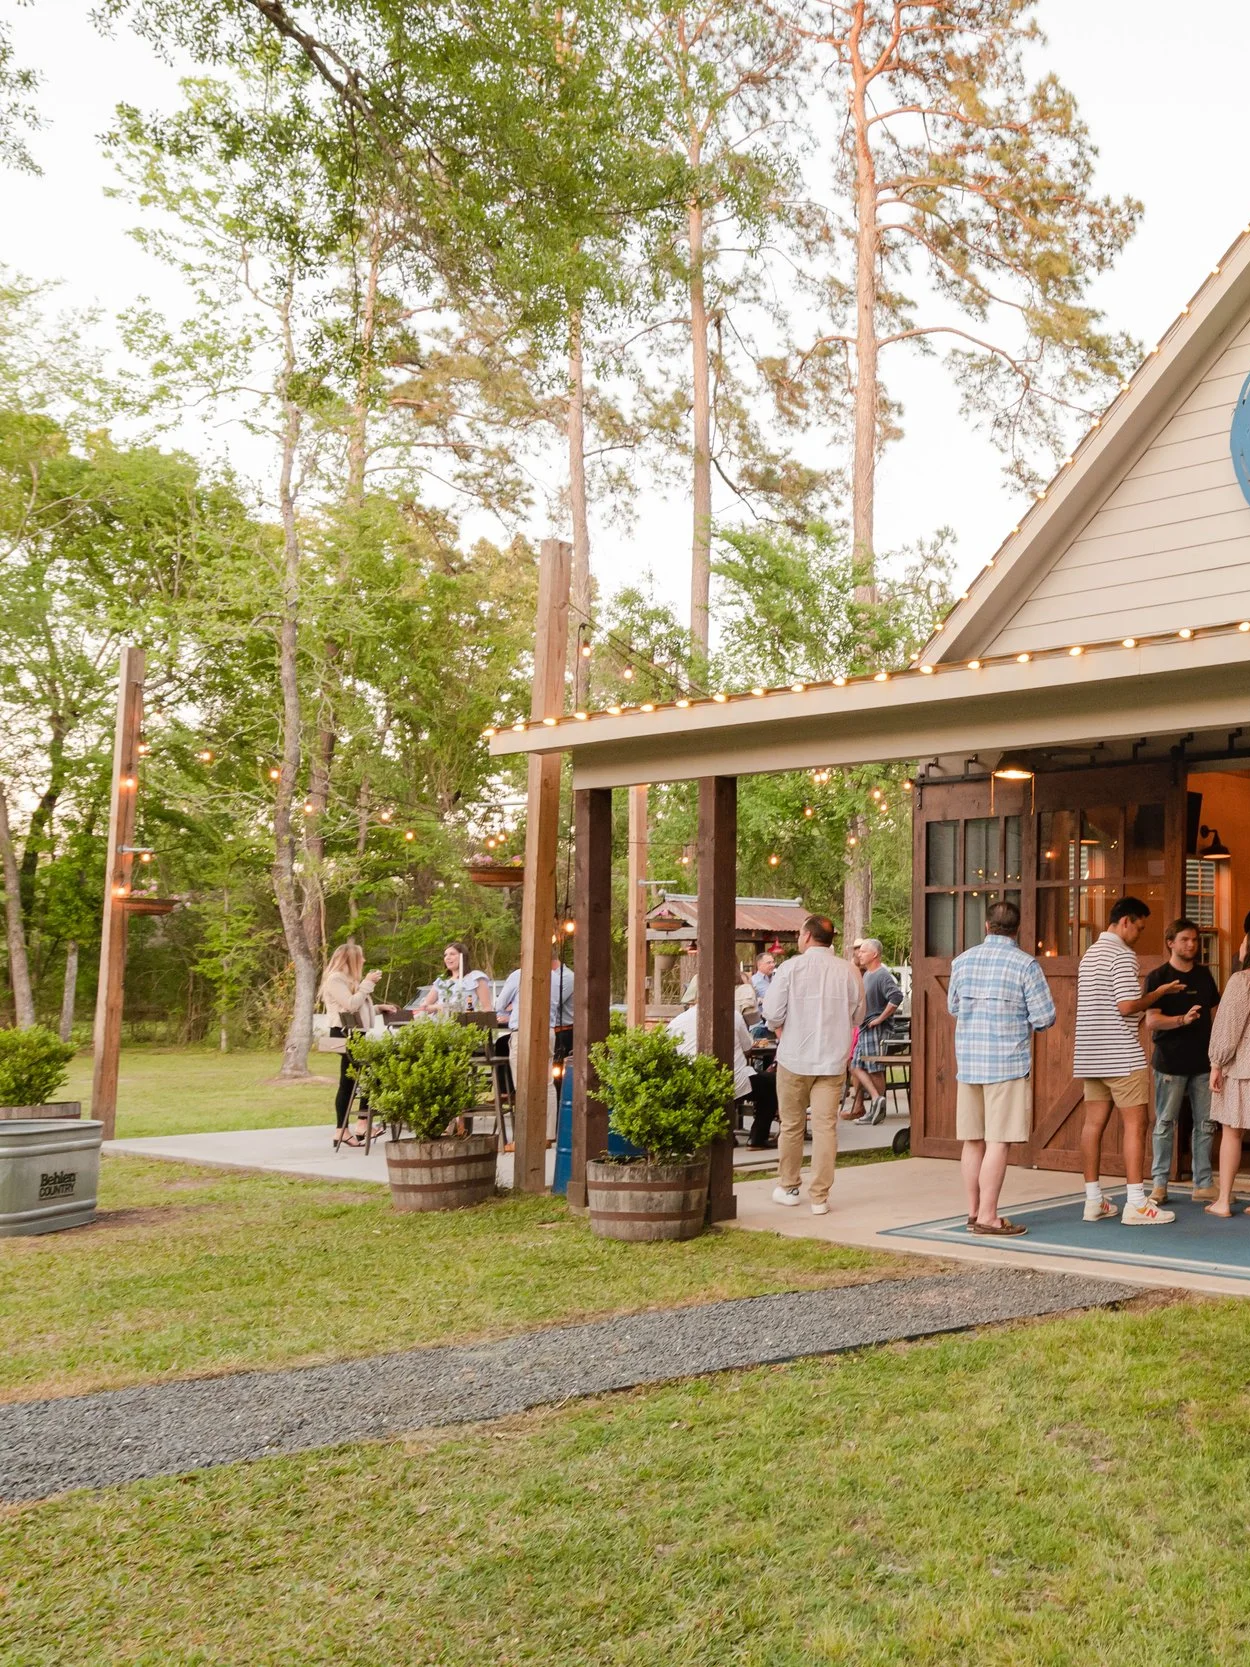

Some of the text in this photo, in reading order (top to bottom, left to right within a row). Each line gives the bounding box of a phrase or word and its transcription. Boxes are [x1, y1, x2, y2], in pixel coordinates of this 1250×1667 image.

[40, 1171, 76, 1187] Behlen
[39, 1182, 76, 1198] COUNTRY
[1146, 1208, 1158, 1218] N
